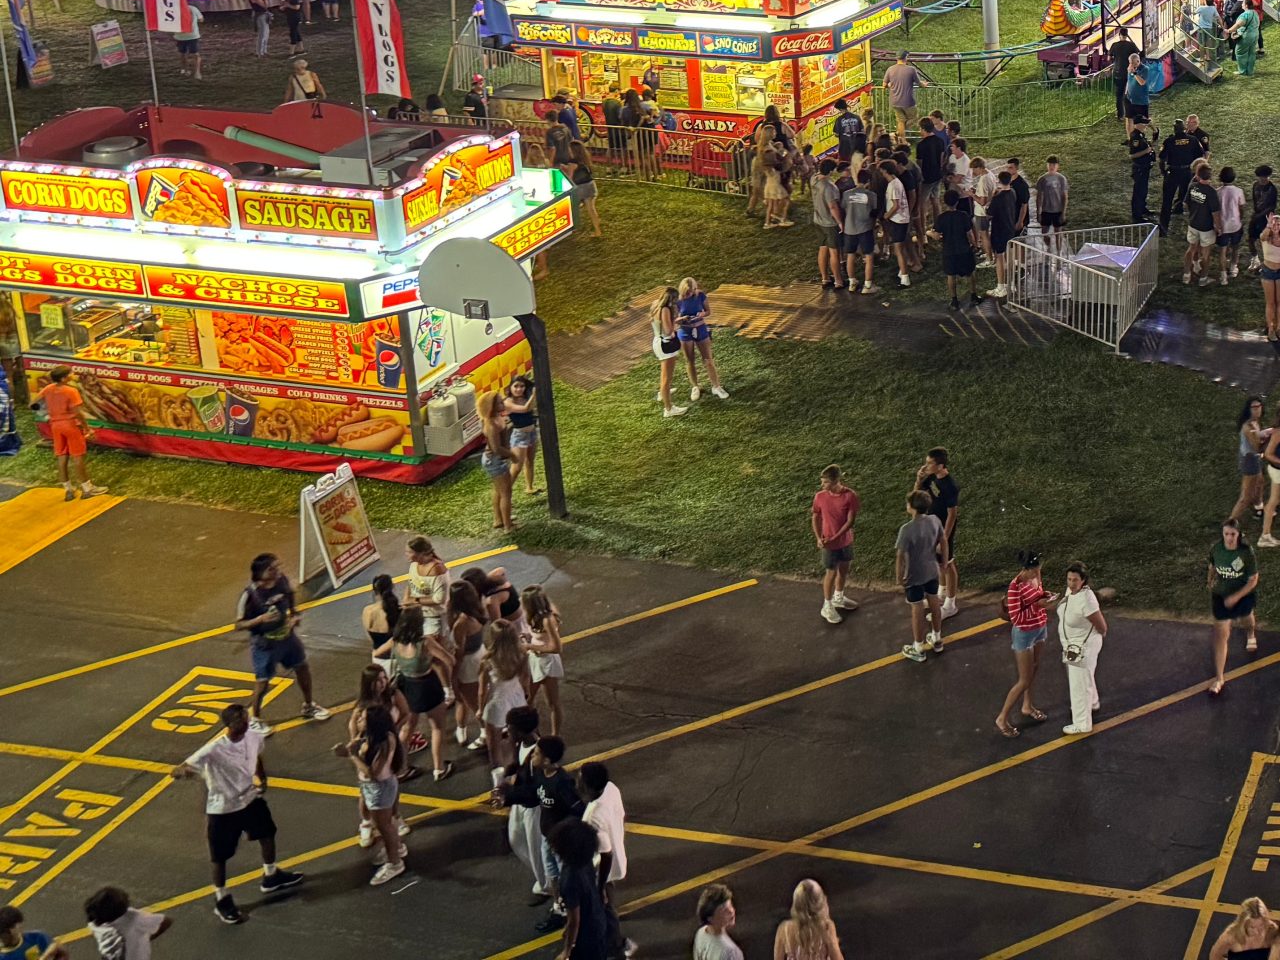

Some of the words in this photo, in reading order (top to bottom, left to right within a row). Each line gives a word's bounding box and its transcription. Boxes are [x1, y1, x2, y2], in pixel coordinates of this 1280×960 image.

[518, 26, 572, 43] POPCORN
[841, 7, 902, 45] LEMONADE
[588, 31, 633, 45] APPLES
[638, 35, 696, 52] LEMONADE
[714, 37, 732, 50] SNO
[732, 39, 757, 52] CONES
[774, 32, 830, 55] Coca-Cola
[376, 22, 398, 84] DOGS
[704, 74, 735, 84] FRESH
[682, 119, 737, 132] CANDY
[476, 159, 495, 189] CORN
[493, 153, 512, 185] DOGS
[9, 180, 67, 209] CORN
[69, 186, 128, 214] DOGS
[243, 199, 372, 234] SAUSAGE
[407, 189, 439, 227] SAUSAGE
[53, 262, 136, 281] CORN
[56, 273, 137, 291] DOGS
[172, 271, 320, 297] NACHOS
[158, 284, 185, 296] &
[194, 286, 340, 311] CHEESE
[72, 365, 95, 375] CORN
[97, 368, 120, 377] DOGS
[127, 372, 146, 381] HOT
[147, 374, 172, 383] DOGS
[233, 383, 279, 395] SAUSAGES
[287, 389, 312, 398] COLD
[313, 391, 348, 402] DRINKS
[357, 396, 404, 408] PRETZELS
[333, 497, 357, 518] DOGS
[152, 683, 254, 734] NO
